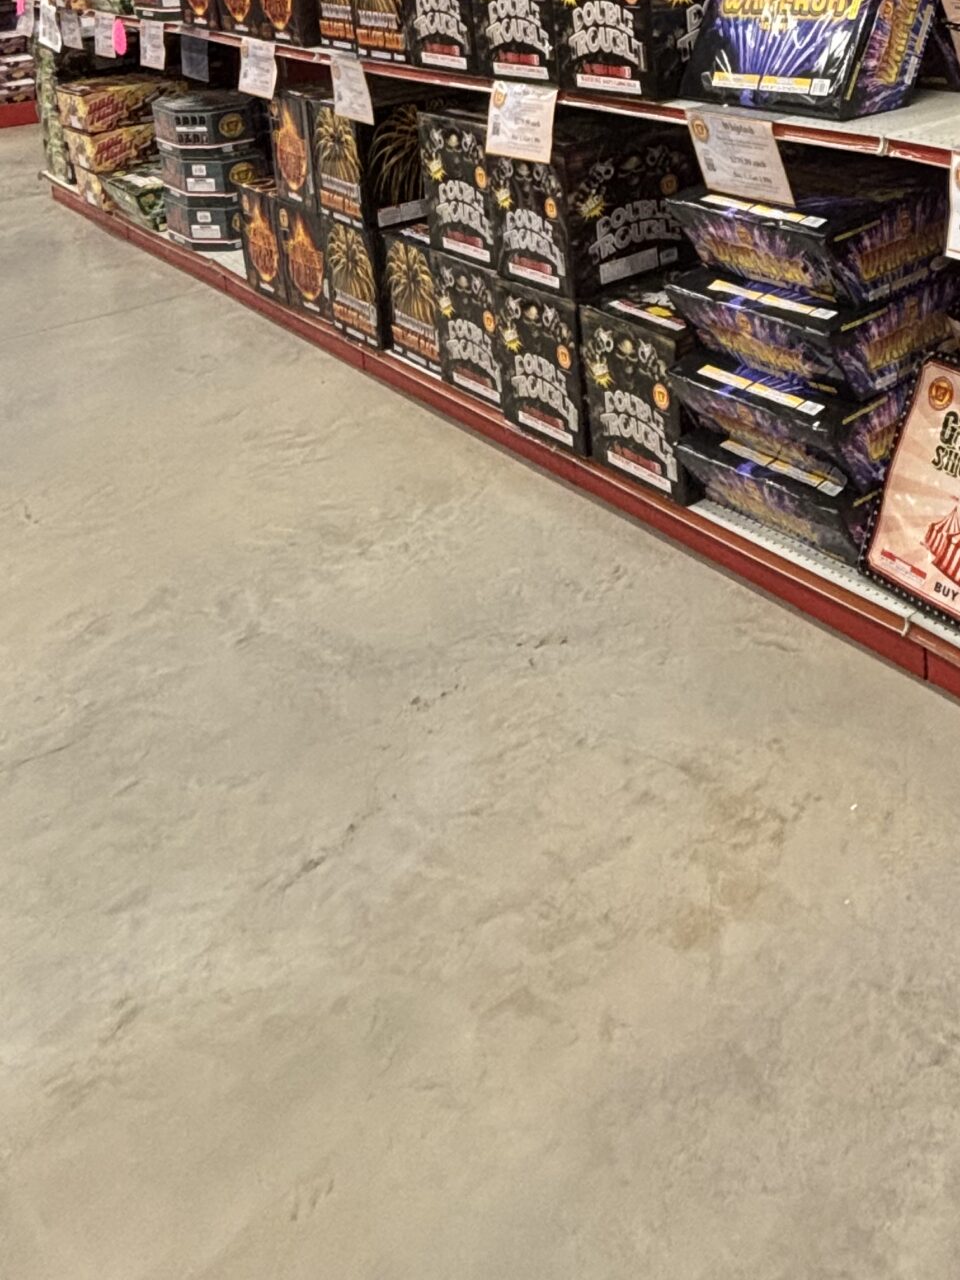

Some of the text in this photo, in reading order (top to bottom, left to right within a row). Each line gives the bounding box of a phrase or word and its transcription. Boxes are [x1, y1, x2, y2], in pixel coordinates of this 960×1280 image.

[572, 0, 634, 36] DOUBLE
[485, 18, 550, 60] TROUBLE
[569, 26, 647, 71] TROUBLE
[933, 581, 960, 600] BUY
